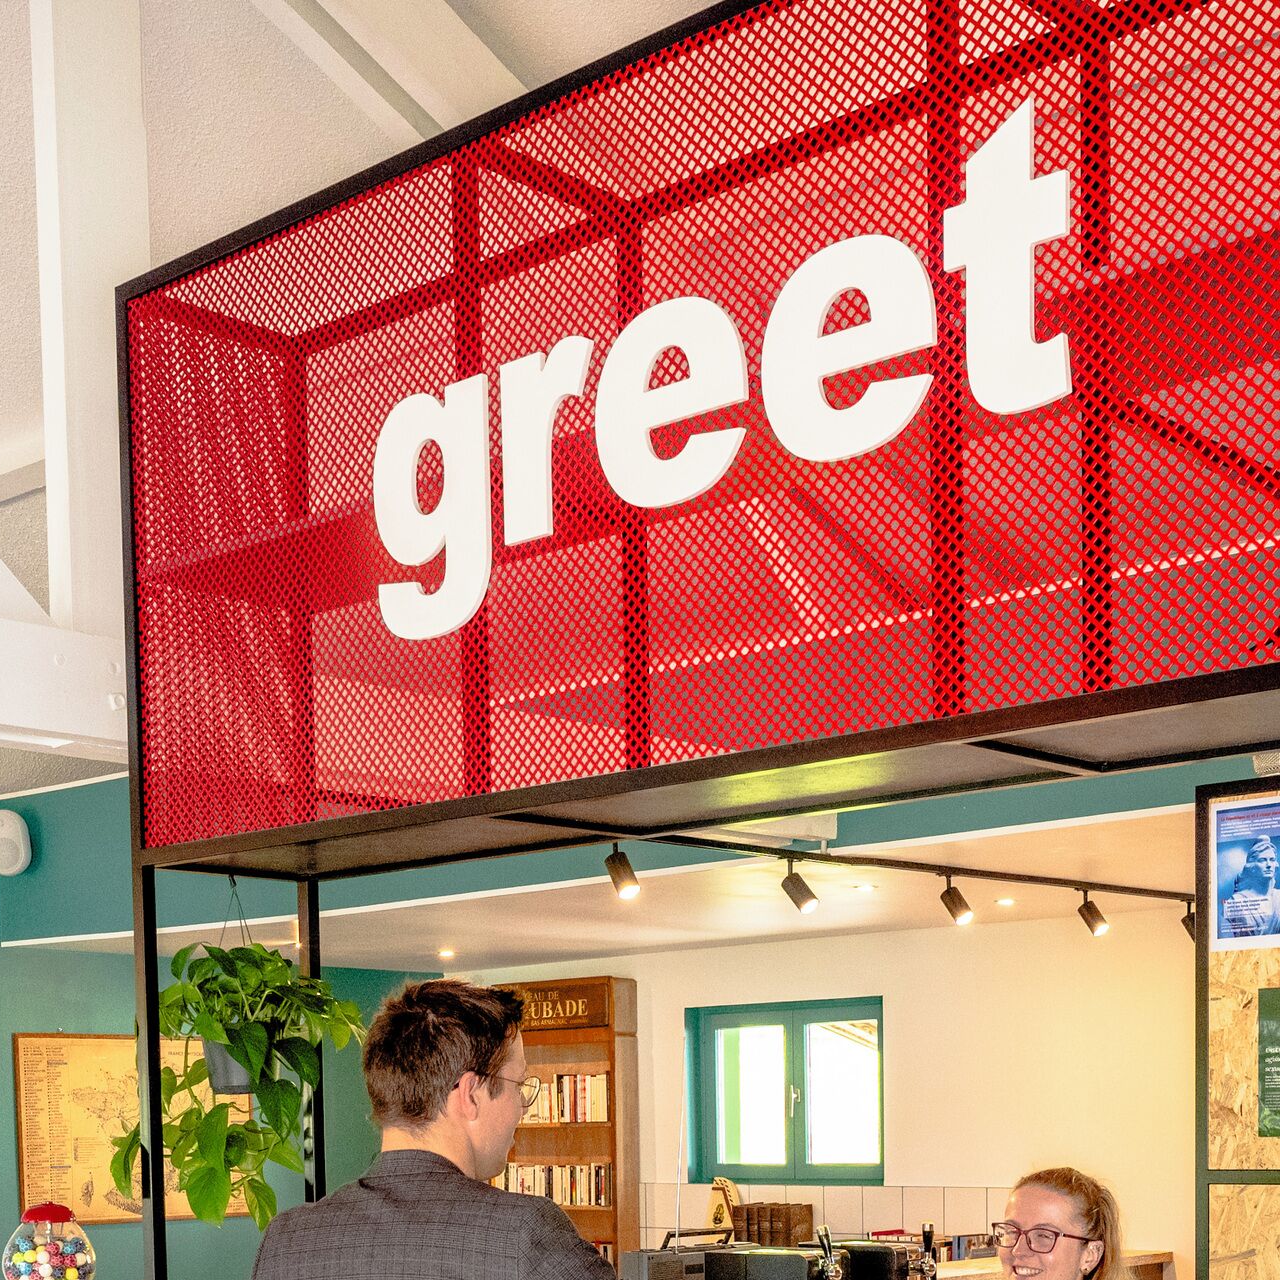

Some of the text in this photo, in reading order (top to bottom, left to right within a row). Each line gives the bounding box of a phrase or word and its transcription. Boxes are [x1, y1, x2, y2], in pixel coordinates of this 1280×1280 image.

[373, 97, 1072, 641] greet
[548, 991, 559, 1000] DE
[526, 999, 588, 1019] UBADE
